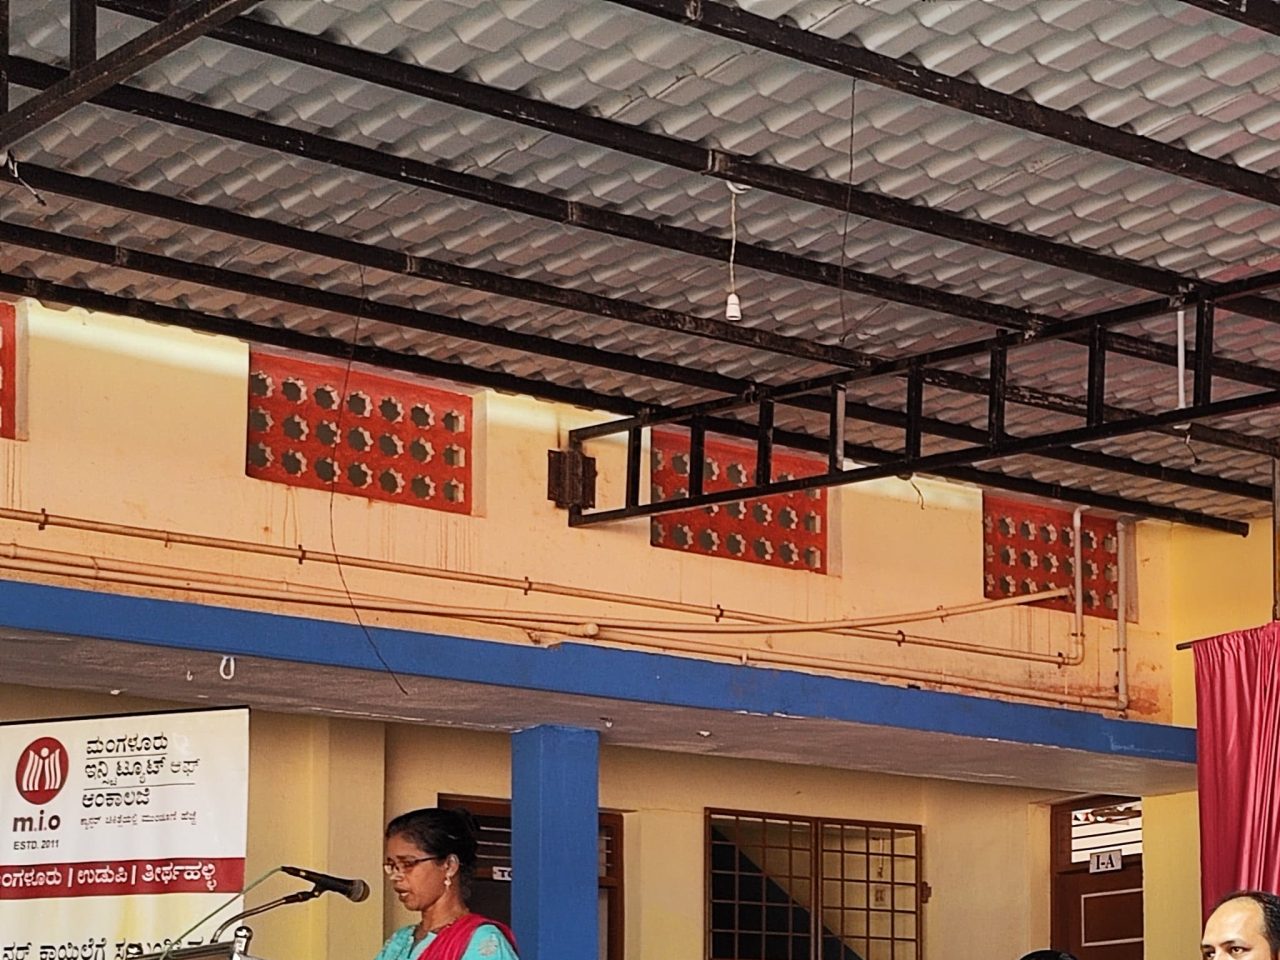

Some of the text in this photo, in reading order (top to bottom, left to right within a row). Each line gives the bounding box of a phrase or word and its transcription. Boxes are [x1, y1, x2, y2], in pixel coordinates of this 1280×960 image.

[86, 732, 168, 754] ಮಂಗಳೂರು
[13, 810, 61, 832] m.i.o
[41, 839, 60, 849] 2011
[1095, 853, 1115, 870] I-A
[0, 867, 62, 888] ಂಗಳೂರು
[77, 864, 128, 885] ಉಡುಪಿ
[142, 861, 217, 891] ತೀರ್ಥಹಳ್ಳಿ
